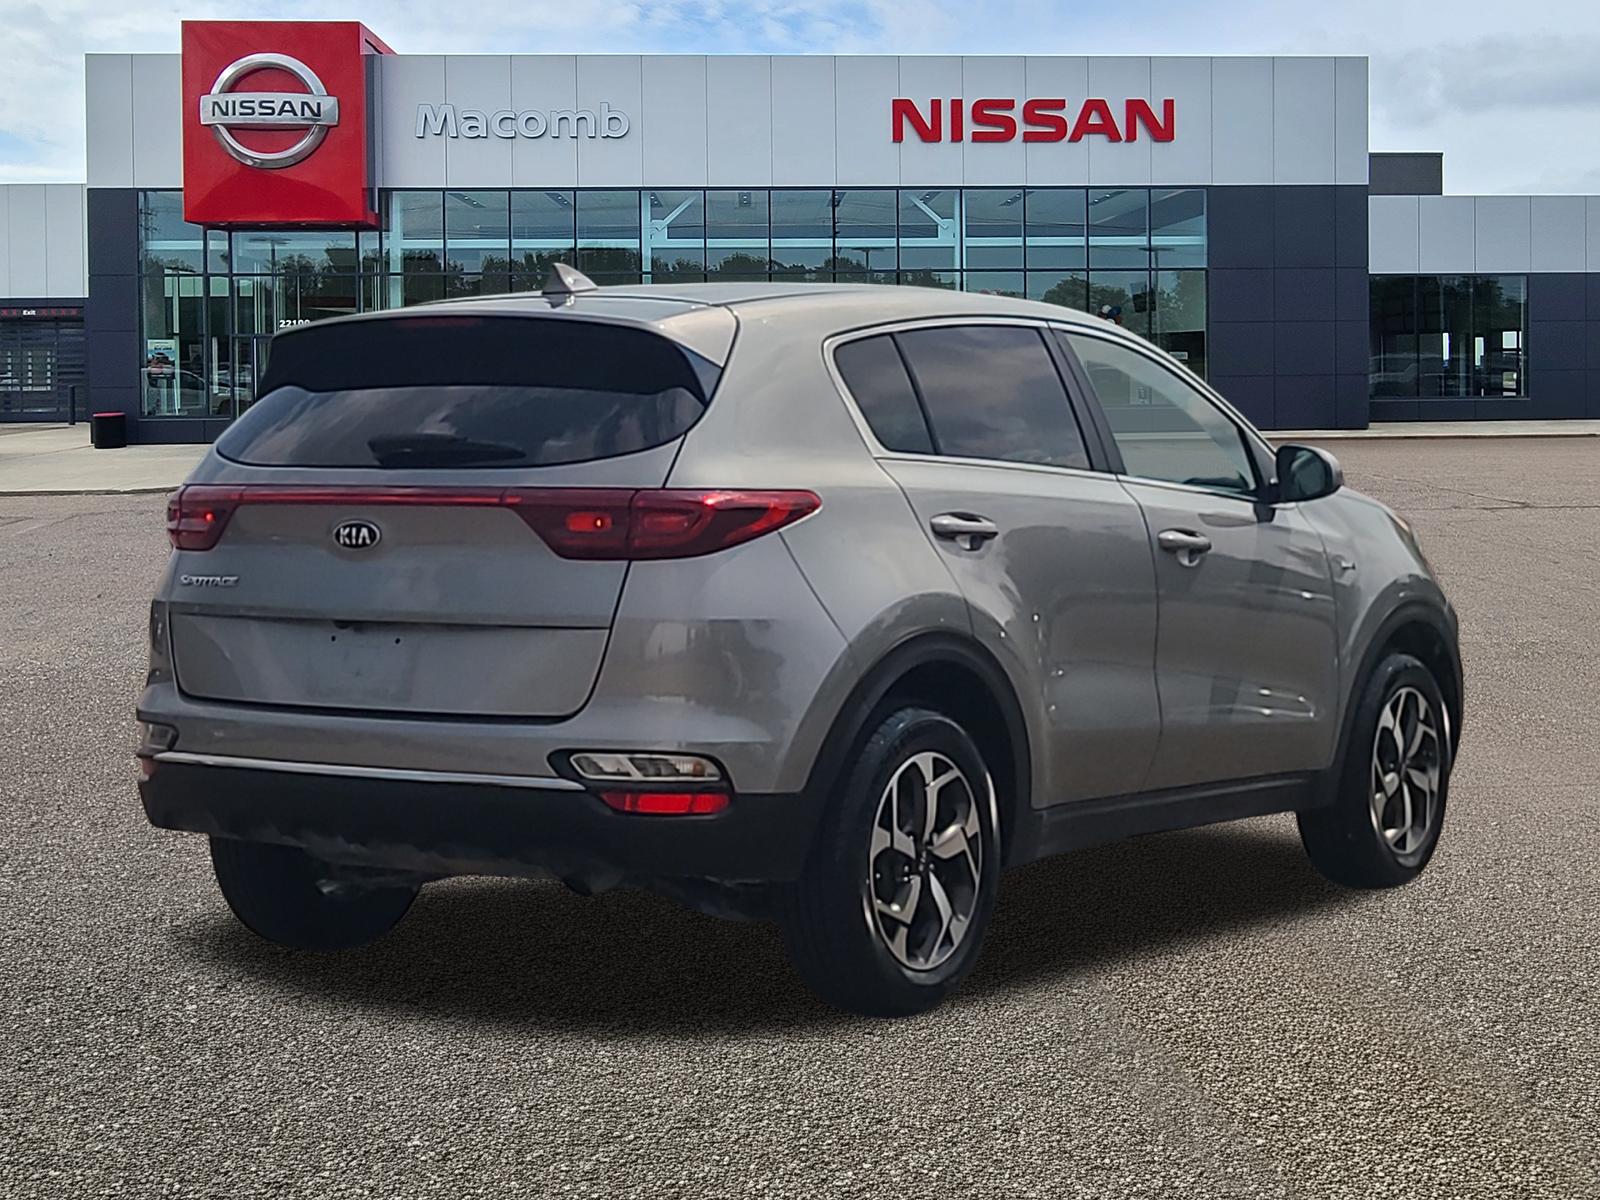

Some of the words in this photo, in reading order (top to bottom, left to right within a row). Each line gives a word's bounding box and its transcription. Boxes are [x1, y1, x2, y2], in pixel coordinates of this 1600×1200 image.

[211, 99, 322, 118] NISSAN
[415, 102, 630, 139] Macomb
[891, 98, 1175, 143] NISSAN
[22, 308, 36, 316] Exit
[339, 526, 371, 545] KIA
